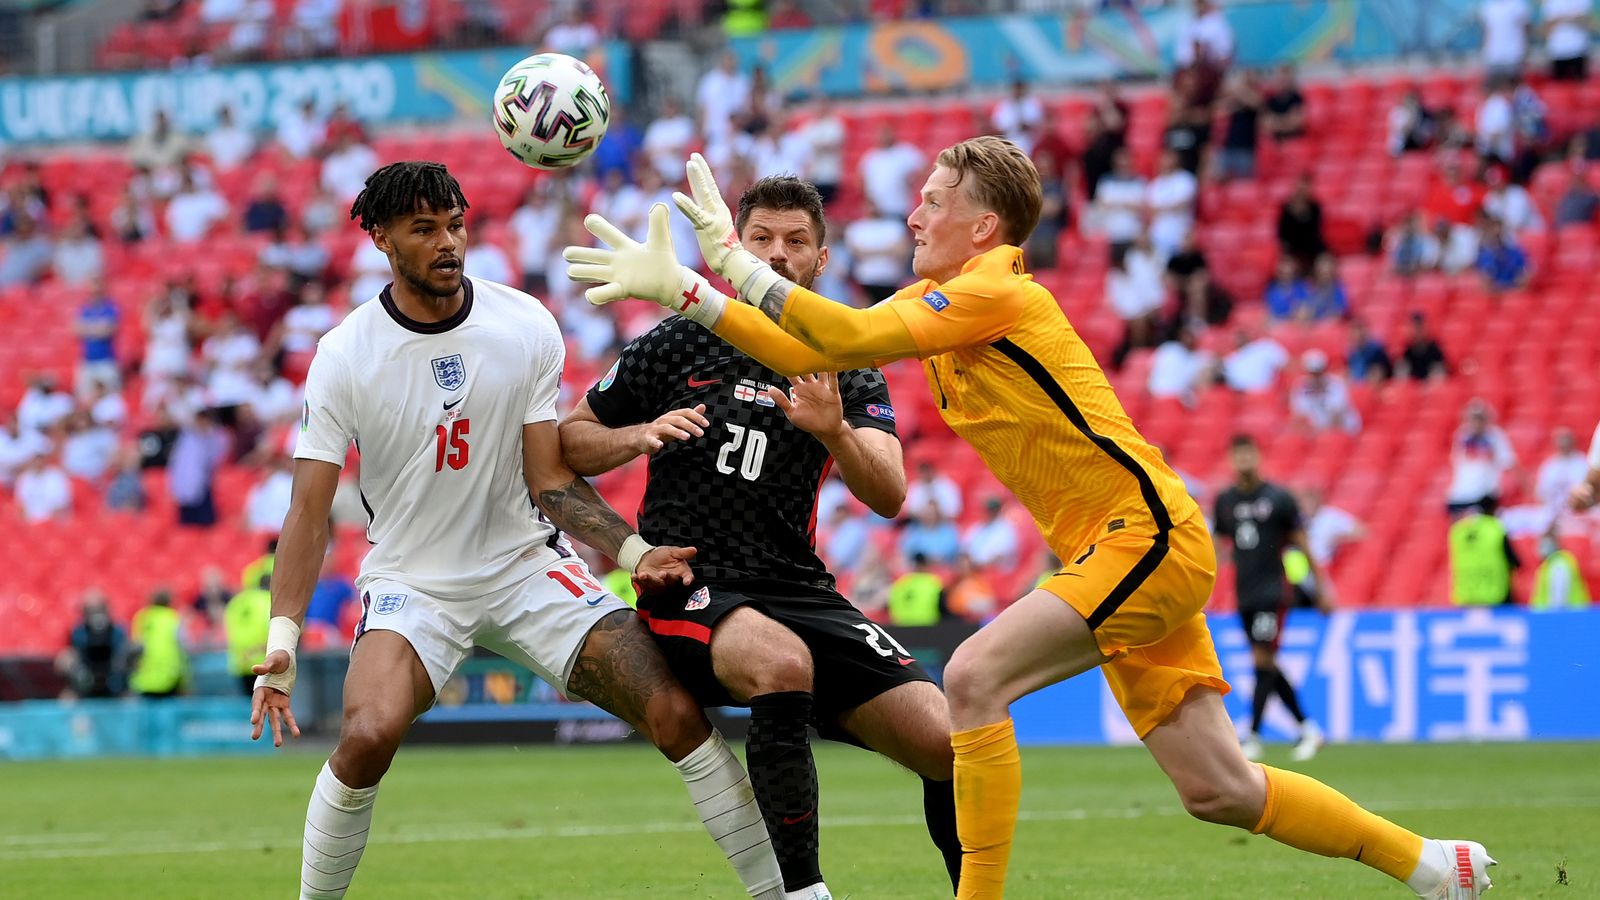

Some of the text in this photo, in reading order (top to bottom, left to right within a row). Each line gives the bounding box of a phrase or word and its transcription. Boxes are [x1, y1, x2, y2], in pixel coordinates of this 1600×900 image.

[2, 78, 133, 140] UEFA
[435, 418, 470, 473] 15
[716, 422, 768, 482] 20
